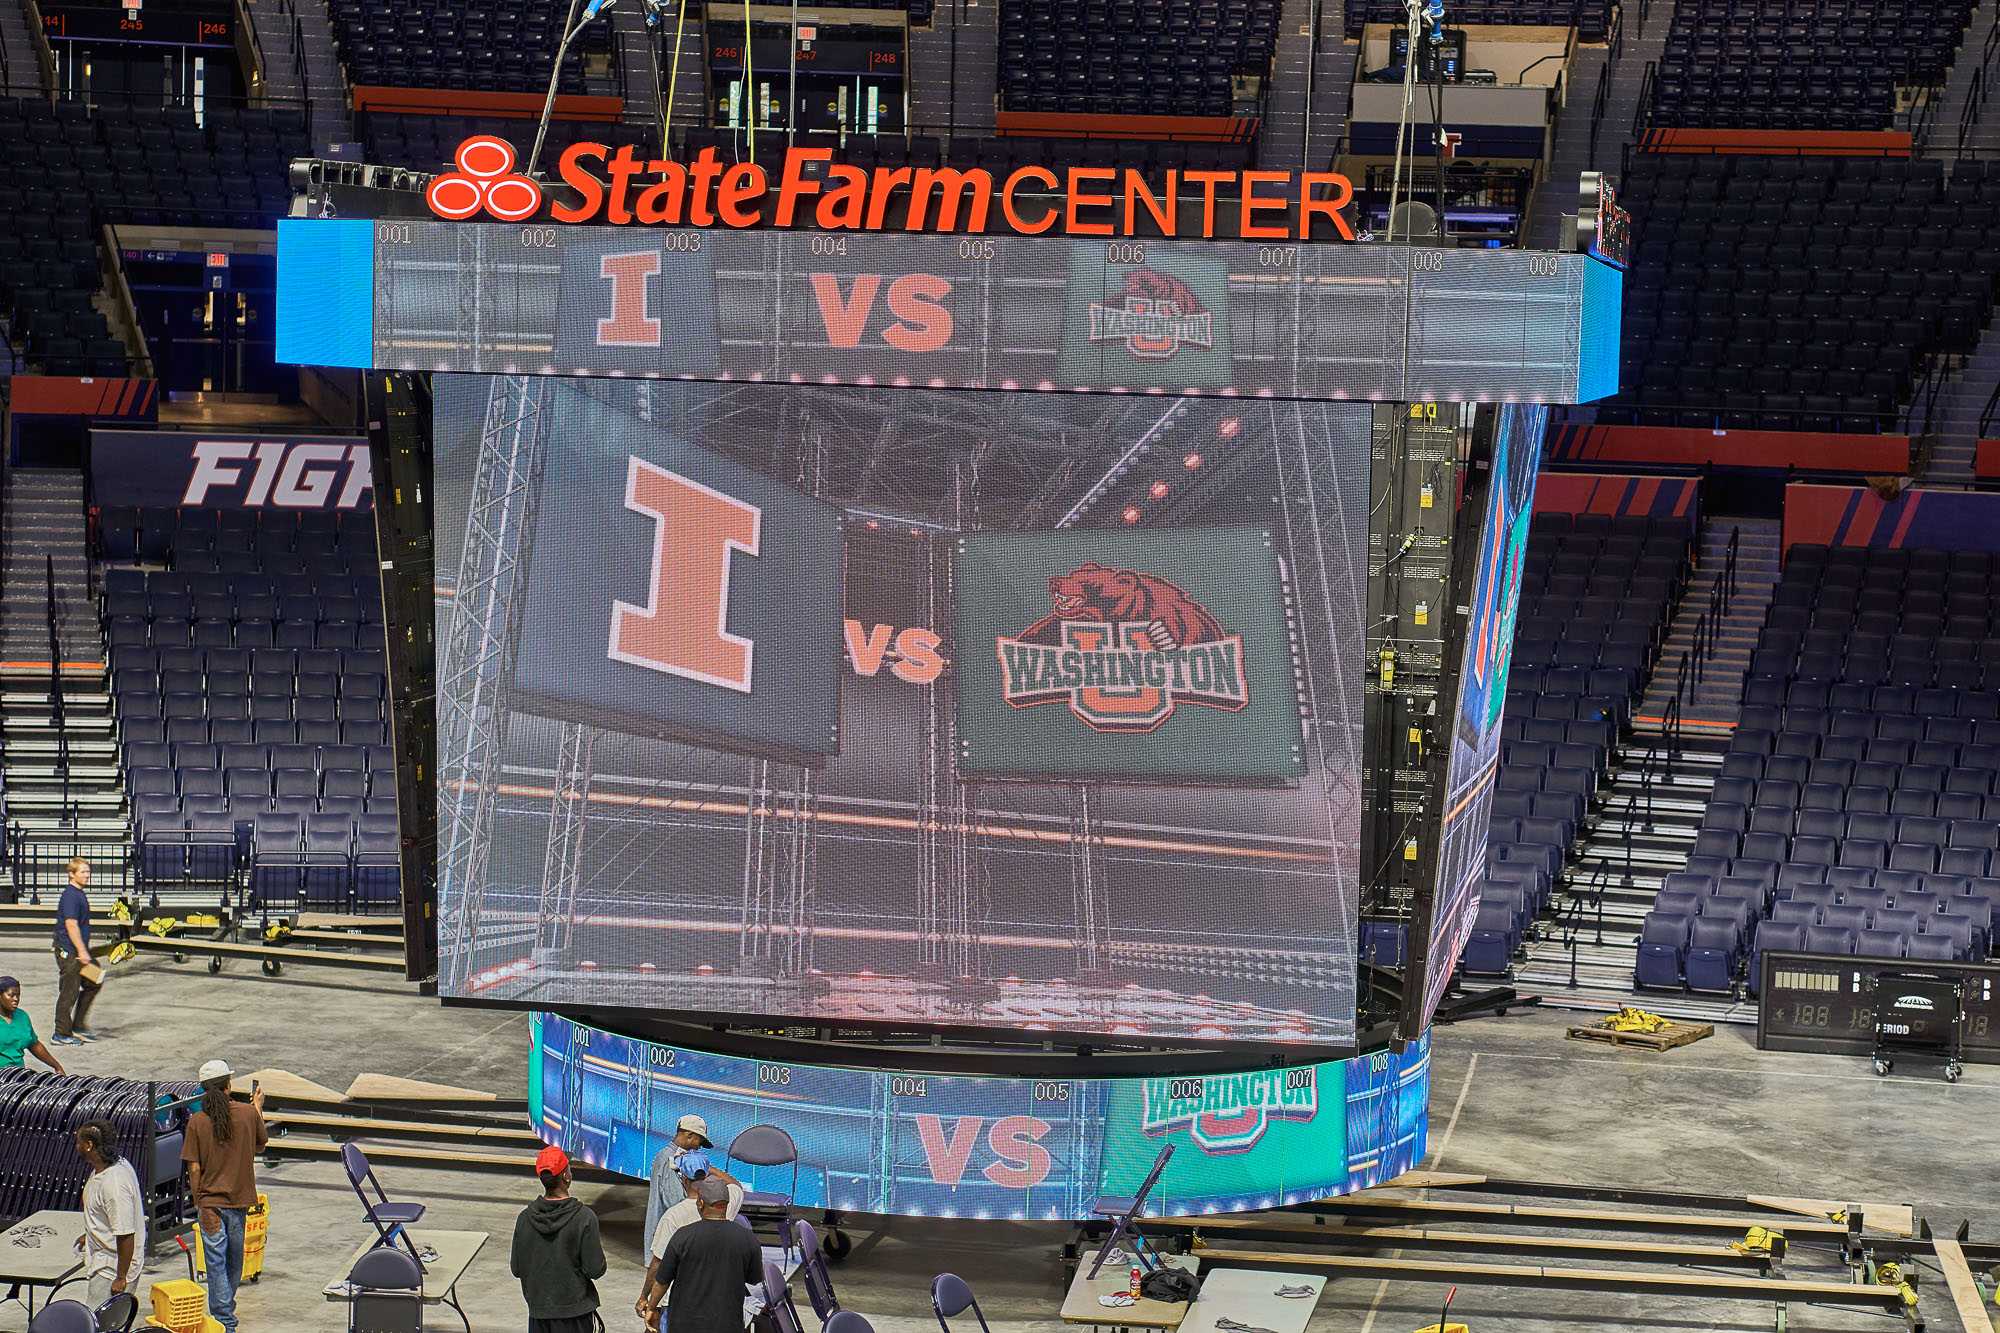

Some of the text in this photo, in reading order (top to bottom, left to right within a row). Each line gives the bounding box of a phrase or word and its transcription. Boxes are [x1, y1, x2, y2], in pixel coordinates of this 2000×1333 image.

[120, 19, 143, 31] 245
[204, 24, 226, 35] 246
[715, 47, 737, 58] 246
[796, 51, 817, 61] 247
[874, 53, 896, 64] 248
[1002, 165, 1355, 241] CENTER
[378, 224, 412, 244] 001
[521, 228, 557, 248] 002
[665, 232, 701, 252] 003
[811, 236, 847, 256] 004
[959, 240, 995, 260] 005
[1108, 244, 1145, 263] 006
[1259, 247, 1296, 266] 007
[1414, 251, 1443, 271] 008
[1529, 256, 1558, 276] 009
[810, 272, 954, 352] VS
[608, 455, 761, 693] I
[844, 619, 943, 685] VS
[1002, 641, 1244, 696] WASHINGTON
[574, 1026, 590, 1047] 001
[1875, 1023, 1910, 1035] PERIOD
[651, 1046, 675, 1067] 002
[1371, 1053, 1388, 1074] 008
[759, 1065, 792, 1085] 003
[1287, 1070, 1312, 1089] 007
[892, 1078, 927, 1097] 004
[1034, 1083, 1069, 1101] 005
[1171, 1079, 1202, 1098] 006
[915, 1113, 1051, 1188] VS
